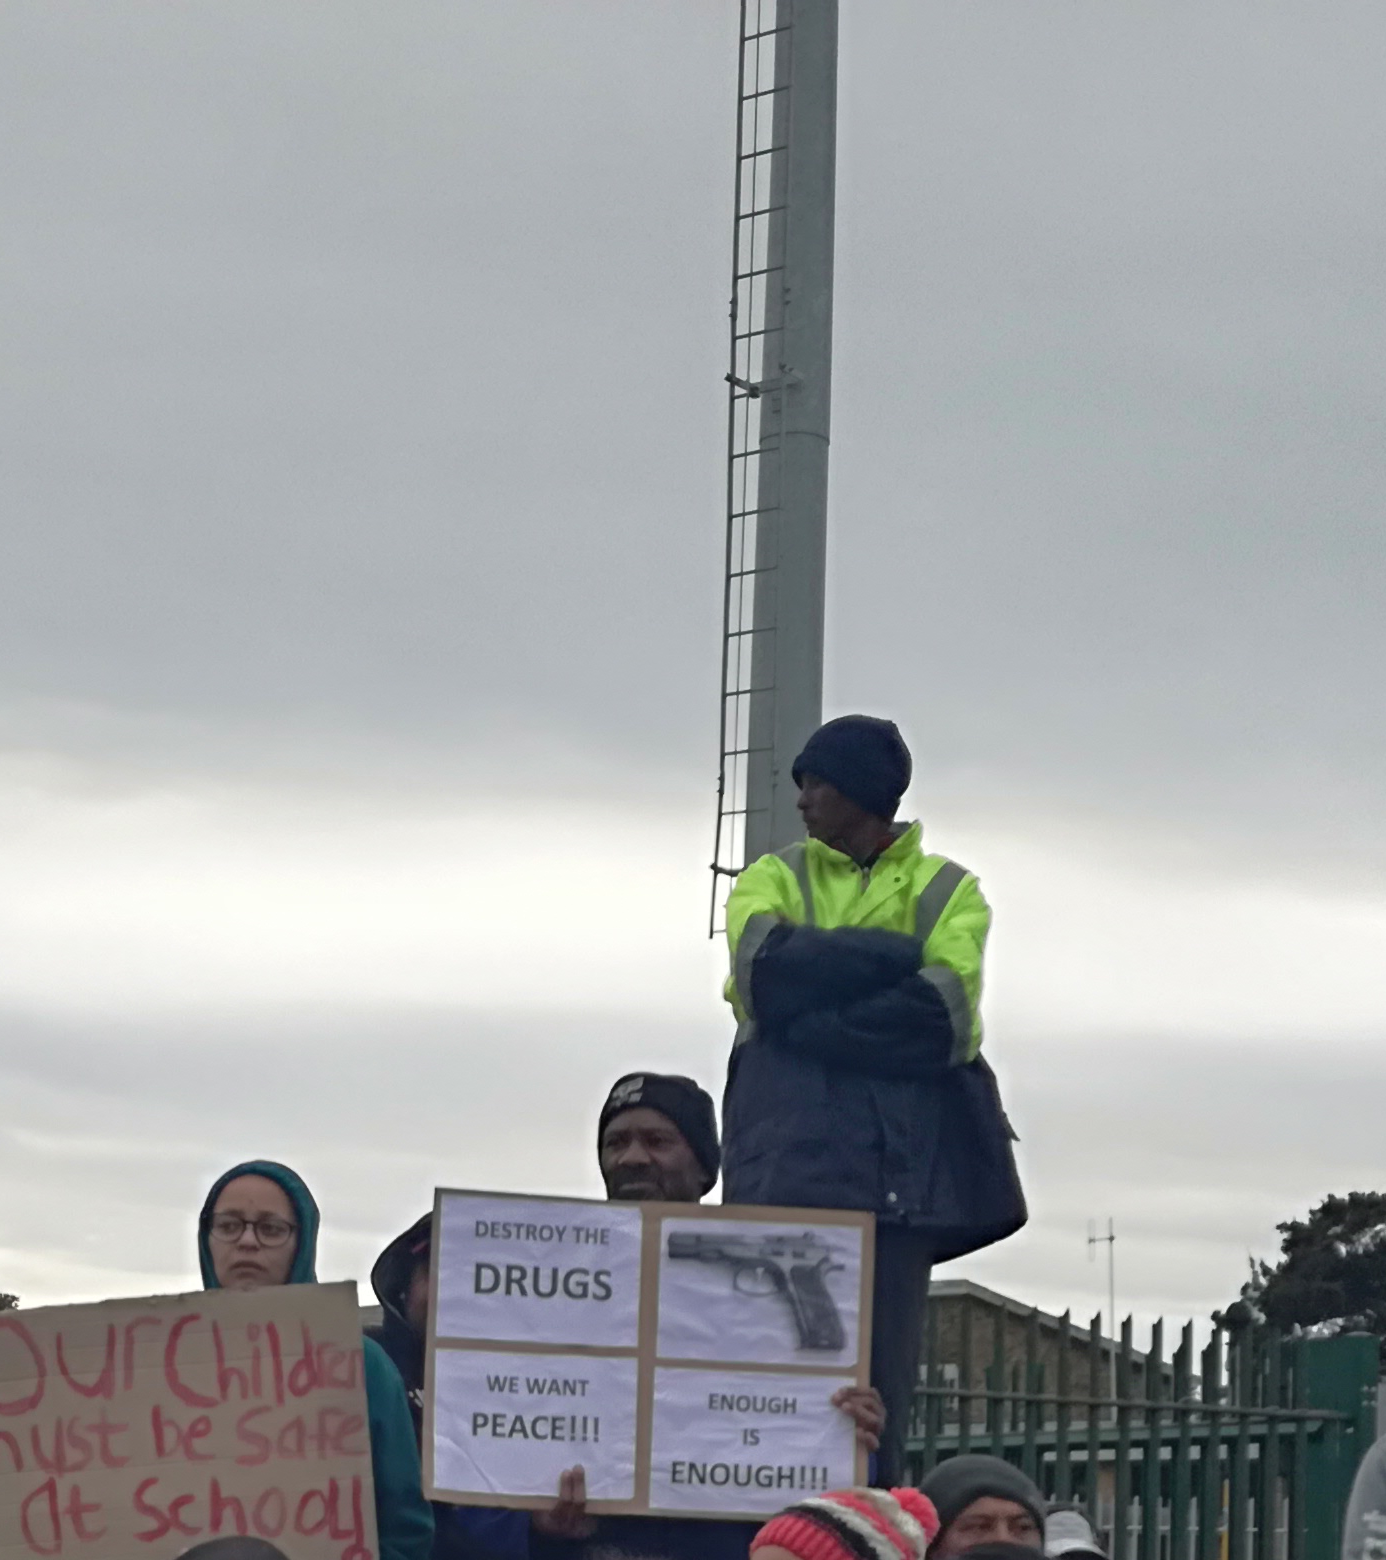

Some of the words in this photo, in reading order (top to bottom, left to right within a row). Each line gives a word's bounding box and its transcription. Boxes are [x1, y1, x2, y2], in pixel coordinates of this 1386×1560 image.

[474, 1219, 567, 1244] DESTROY
[571, 1225, 610, 1246] THE
[473, 1262, 613, 1302] DRUGS
[486, 1374, 520, 1395] WE
[524, 1376, 590, 1398] WANT
[708, 1392, 798, 1416] ENOUGH
[151, 1404, 217, 1462] be
[470, 1411, 601, 1443] PEACE!!!
[742, 1428, 761, 1447] IS
[670, 1460, 829, 1491] ENOUGH!!!
